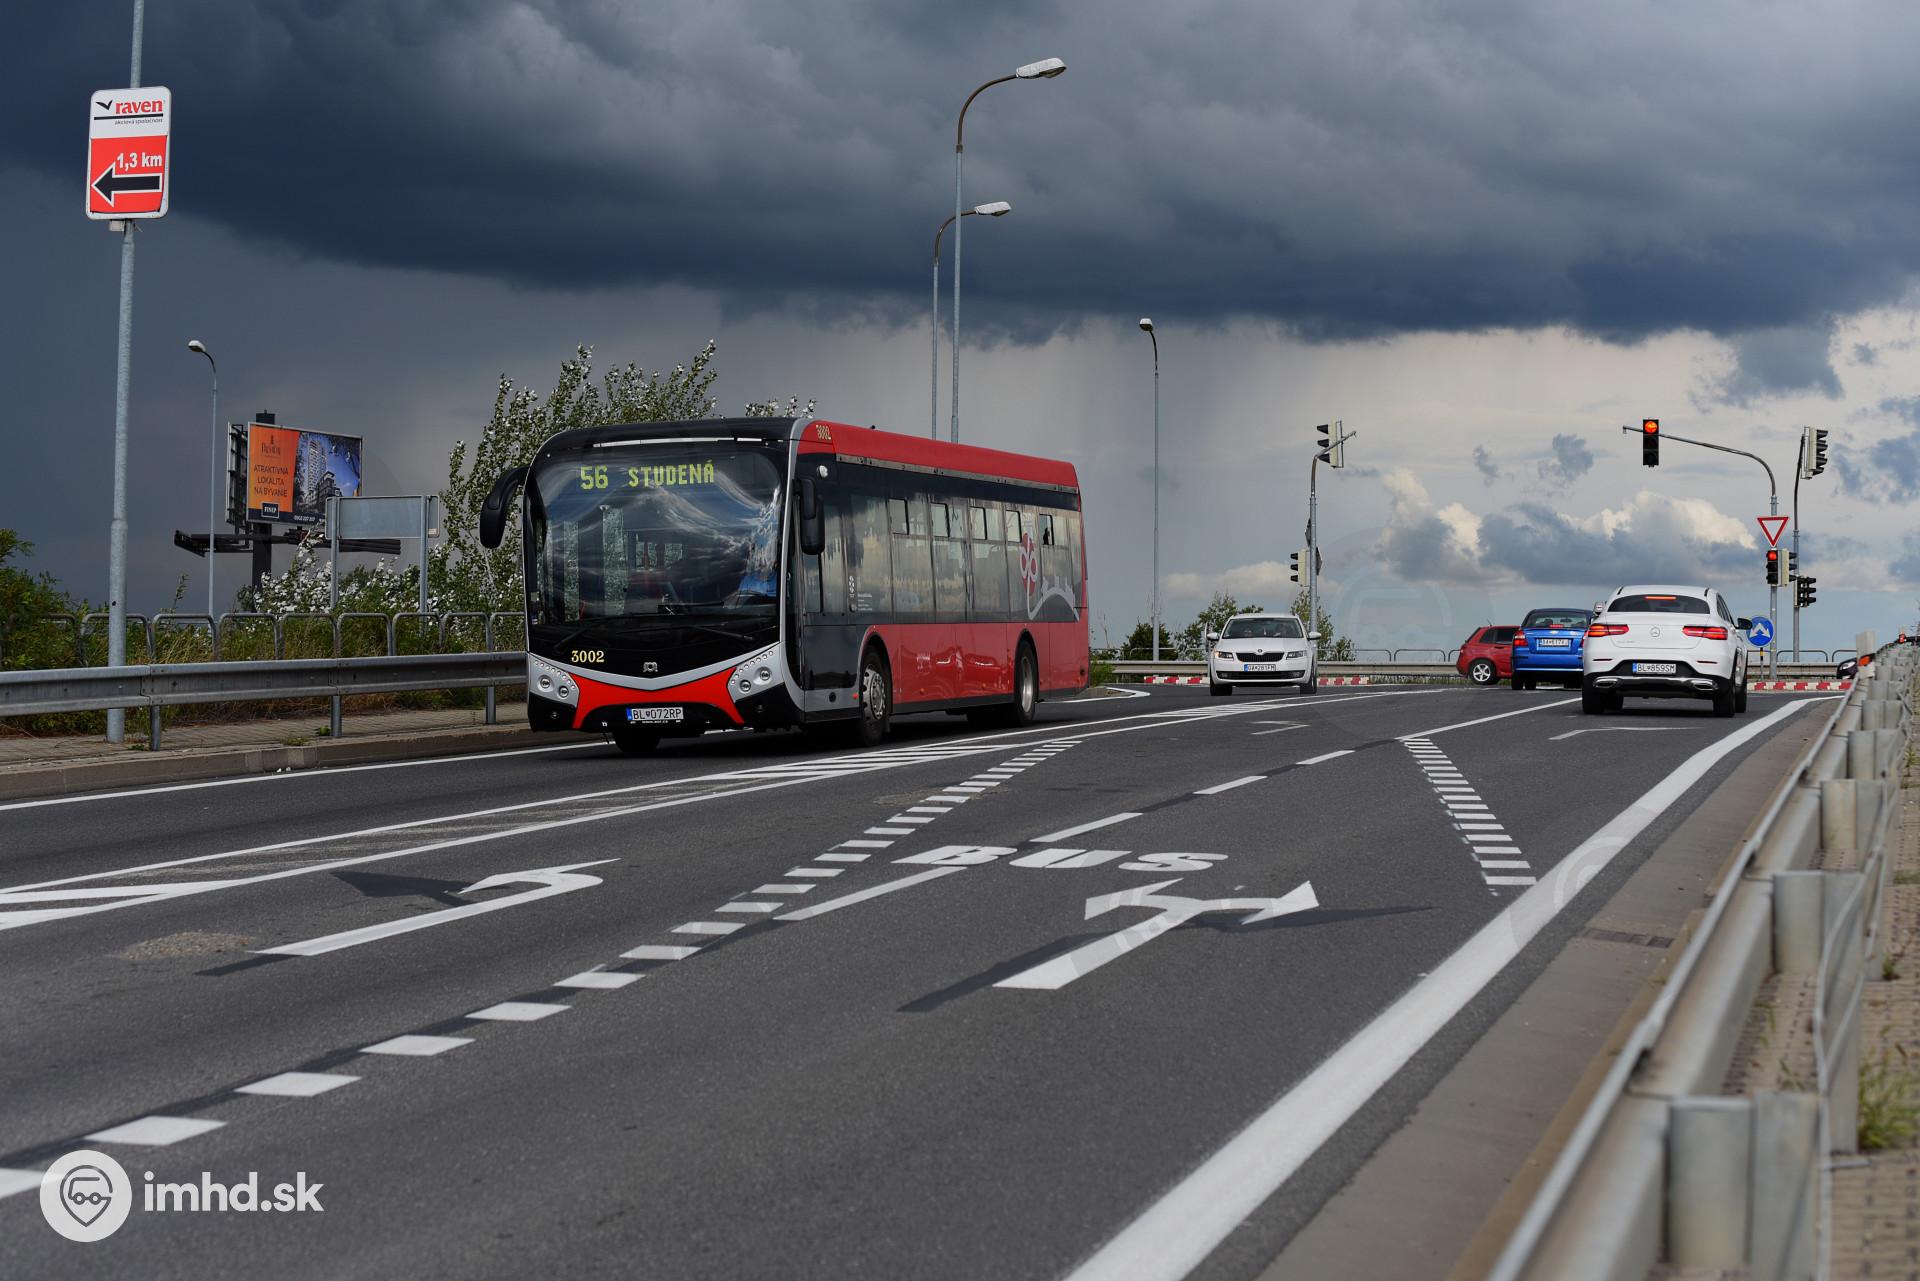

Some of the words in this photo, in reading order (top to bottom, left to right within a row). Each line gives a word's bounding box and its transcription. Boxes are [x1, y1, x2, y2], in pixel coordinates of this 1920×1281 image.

[115, 100, 163, 114] raven
[117, 152, 138, 171] 1,3
[141, 152, 163, 168] km
[580, 465, 608, 489] 56
[628, 459, 715, 488] STUDENÁ
[571, 650, 605, 663] 3002
[891, 845, 1229, 871] BUS
